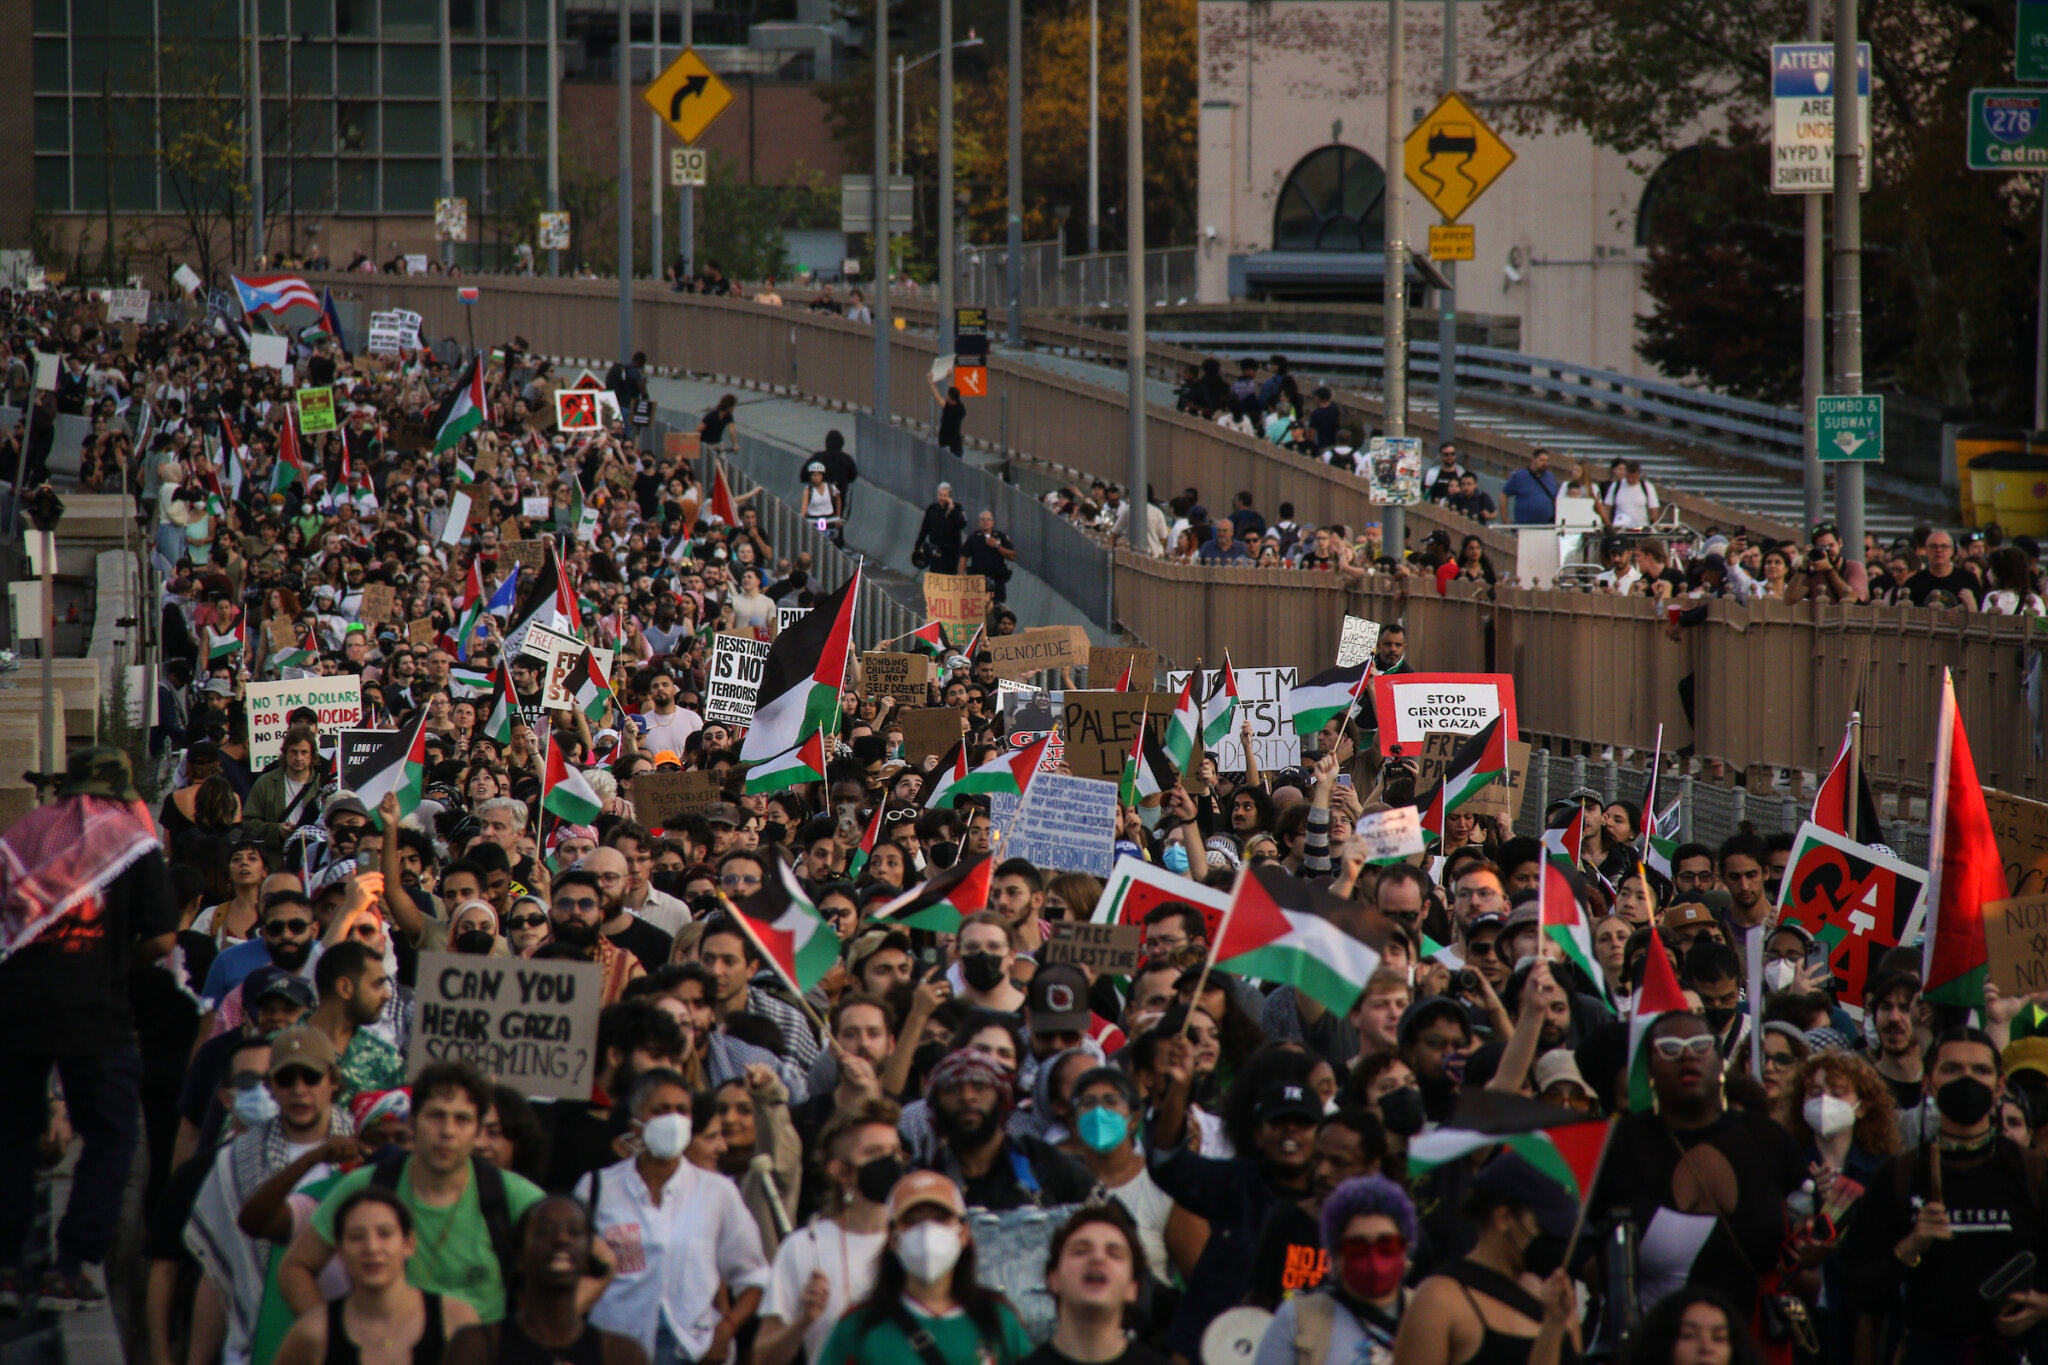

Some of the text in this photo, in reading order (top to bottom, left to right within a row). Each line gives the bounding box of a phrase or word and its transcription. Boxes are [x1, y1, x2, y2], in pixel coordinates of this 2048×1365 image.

[1779, 51, 1864, 70] ATTENTN
[1800, 101, 1834, 116] ARE
[1993, 110, 2031, 132] 278
[1797, 124, 1834, 139] UNDE
[675, 153, 702, 169] 30
[1778, 146, 1817, 160] NYPD
[1778, 168, 1864, 184] SURVEILLE
[1820, 400, 1878, 413] DUMBO &
[1824, 417, 1872, 429] SUBWAY
[929, 576, 985, 593] PALESTINE
[928, 597, 983, 619] WILL BE
[941, 622, 981, 643] REE
[1345, 617, 1375, 633] STOP
[717, 636, 770, 658] RESISTANC
[993, 639, 1072, 662] GENOCIDE
[715, 652, 733, 678] IS
[866, 657, 908, 667] BOMBING
[866, 683, 925, 694] SELF DEFENSE
[253, 691, 359, 710] NO TAX DOLLARS
[708, 698, 756, 716] FREE PALEST
[1427, 695, 1466, 704] STOP
[254, 713, 280, 726] FOR
[1408, 707, 1487, 717] GENOCIDE
[1418, 719, 1480, 728] IN GAZA
[255, 732, 271, 743] NO
[353, 744, 370, 752] LONG
[439, 968, 576, 1004] CAN YOU
[423, 1003, 571, 1046] HEAR GAZA
